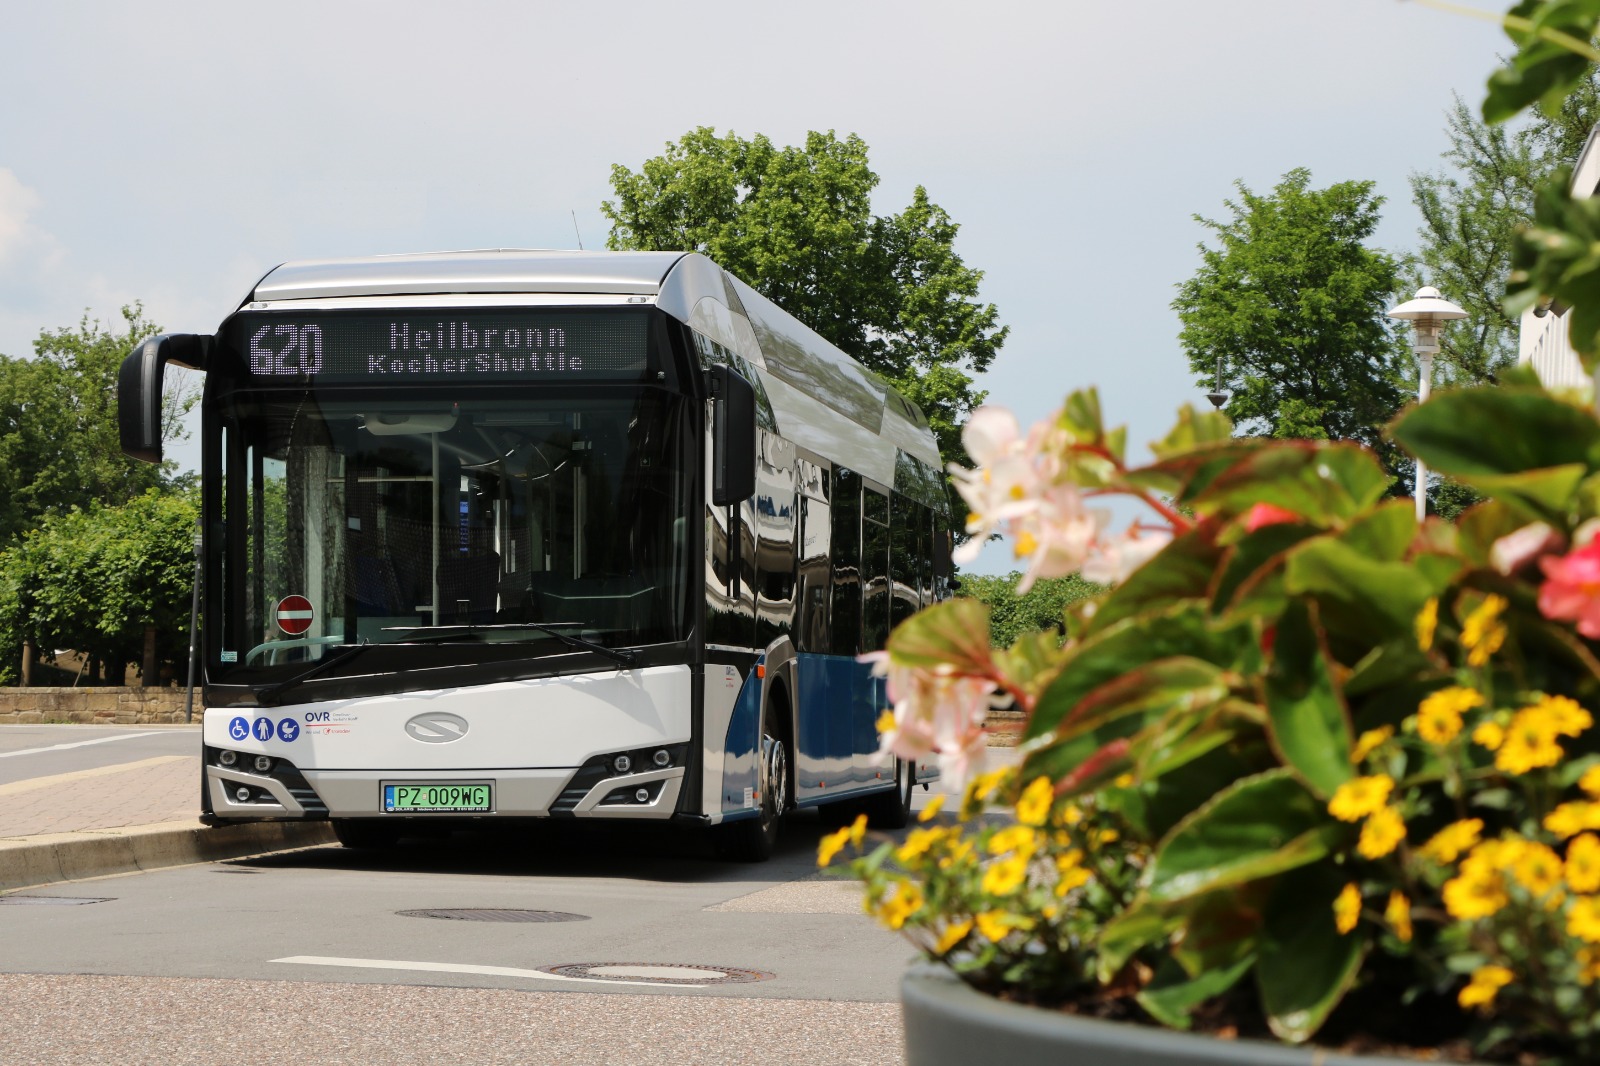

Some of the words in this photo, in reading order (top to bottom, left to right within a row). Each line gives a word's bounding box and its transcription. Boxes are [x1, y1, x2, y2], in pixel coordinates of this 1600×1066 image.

[389, 321, 567, 350] Heilbronn
[250, 323, 323, 375] 620
[367, 352, 583, 374] KocherShuttle
[304, 711, 331, 723] OVR
[398, 788, 421, 806] PZ
[428, 787, 484, 806] 009WG
